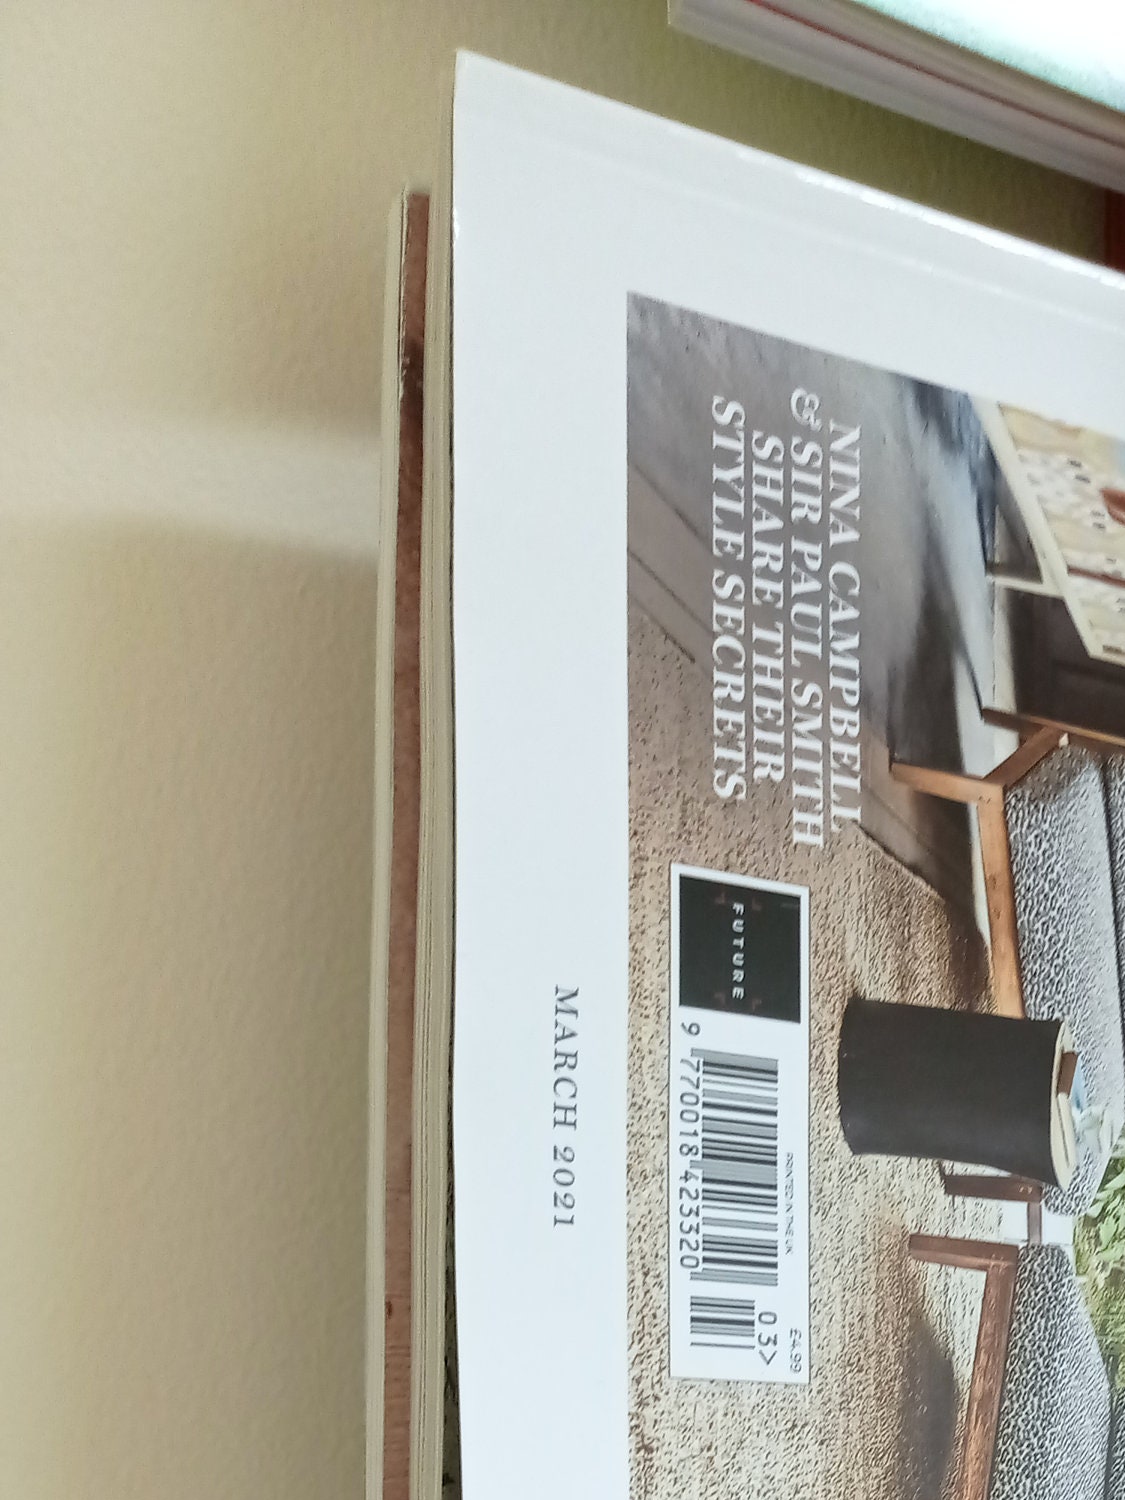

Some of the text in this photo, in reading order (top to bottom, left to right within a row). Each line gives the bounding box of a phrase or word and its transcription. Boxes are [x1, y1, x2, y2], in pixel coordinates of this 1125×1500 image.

[712, 396, 746, 801] STYLE SECRETS
[752, 430, 785, 783] SHARE THEIR
[789, 387, 824, 848] & SIR PAUL SMITH
[829, 419, 862, 833] NINA CAMPBELL
[731, 901, 745, 1000] FUTURE
[552, 984, 580, 1228] MARCH 2021
[679, 1022, 701, 1270] 9 770018 423320
[789, 1328, 802, 1374] £4.99
